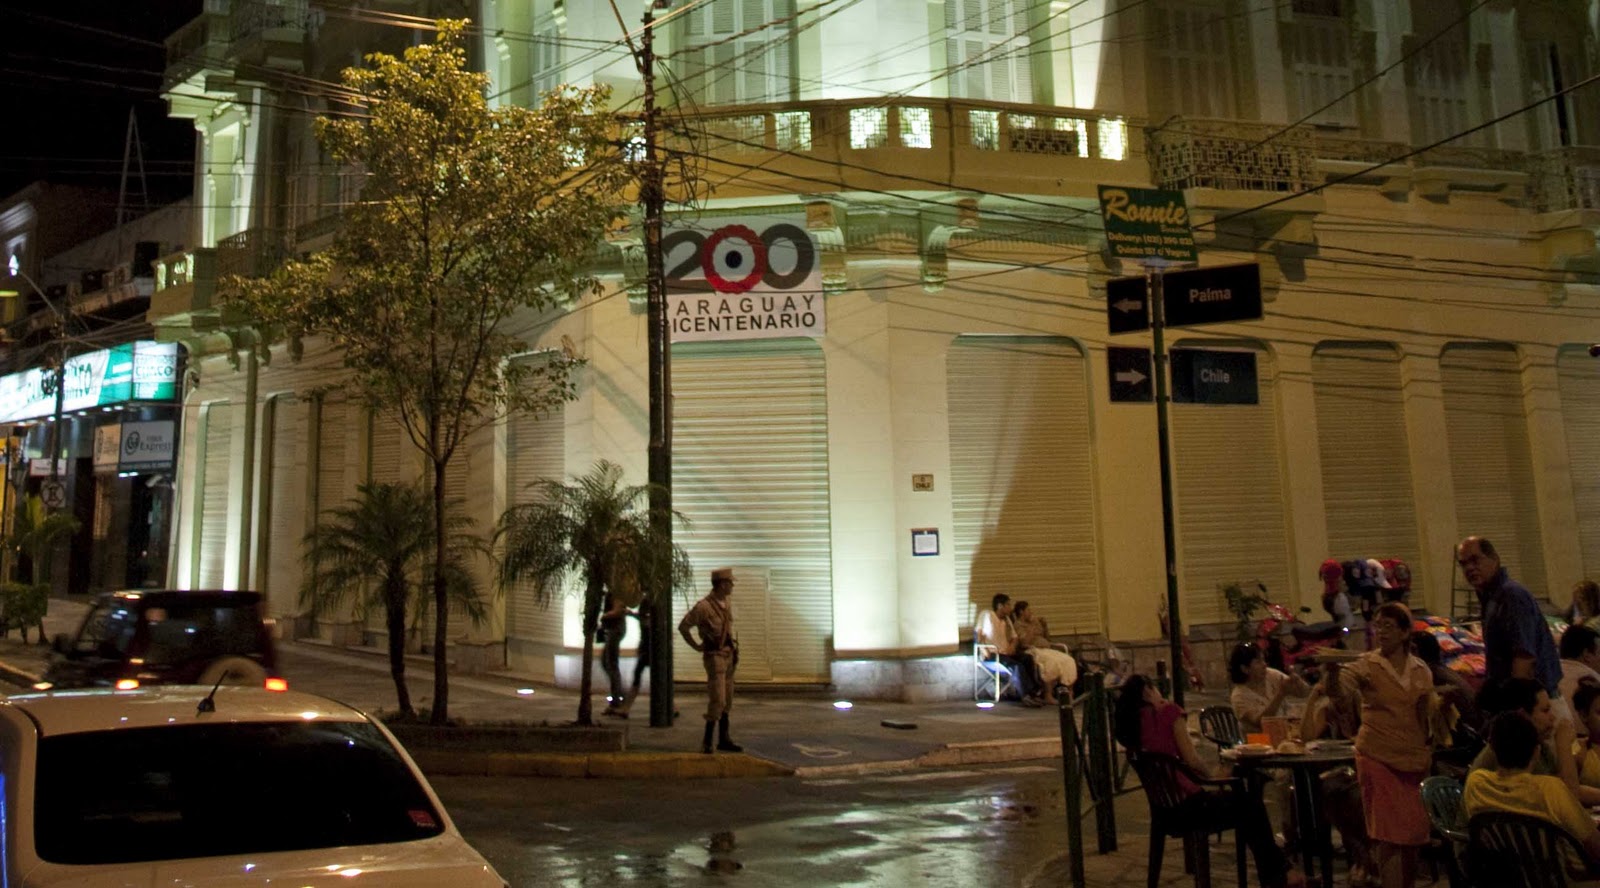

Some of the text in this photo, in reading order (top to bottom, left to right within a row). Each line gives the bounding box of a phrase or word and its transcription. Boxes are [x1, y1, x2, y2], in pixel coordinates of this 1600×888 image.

[1102, 189, 1188, 225] Ronnie
[1189, 287, 1232, 303] Palma
[1200, 368, 1230, 384] Chile
